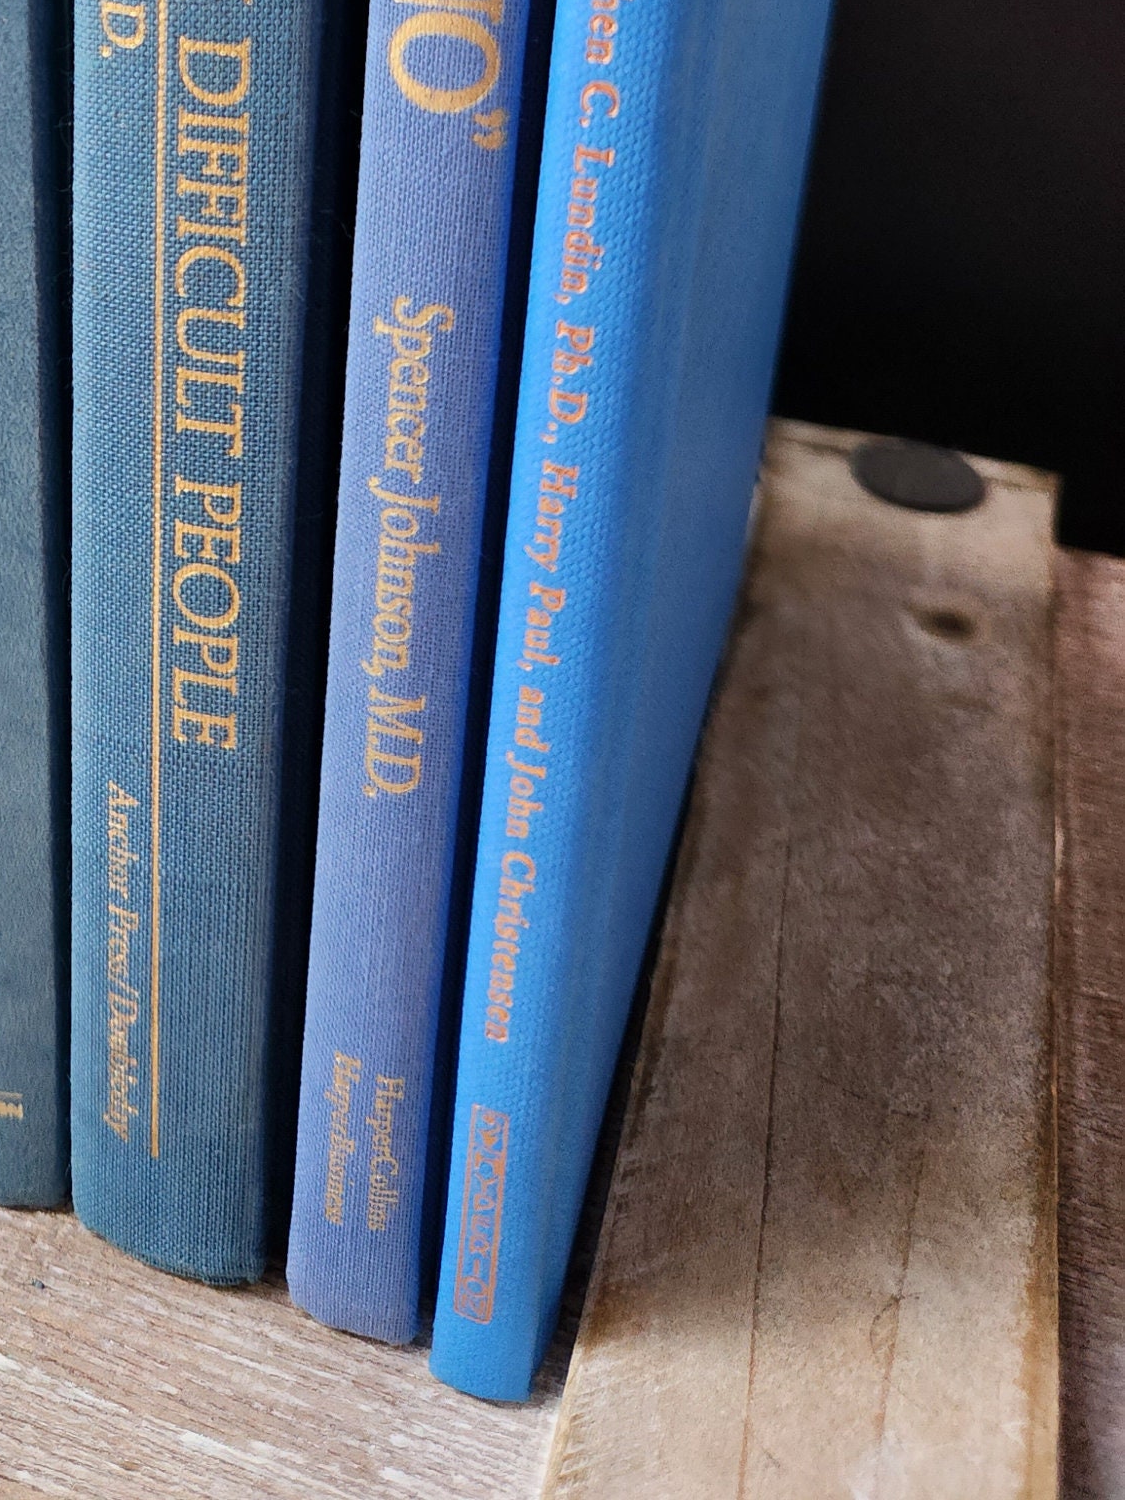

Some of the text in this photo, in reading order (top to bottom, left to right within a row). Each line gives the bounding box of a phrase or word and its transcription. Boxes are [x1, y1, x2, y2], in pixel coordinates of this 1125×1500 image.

[577, 79, 621, 129] C.
[175, 35, 252, 459] DIFFICULT
[554, 143, 616, 305] Lundin,
[540, 318, 596, 445] Ph.D.,
[360, 296, 455, 798] Spencer Johnson, M.D.
[523, 458, 581, 574] Harry
[172, 475, 243, 752] PEOPLE
[516, 581, 568, 673] Paul,
[514, 684, 551, 753] and
[108, 779, 140, 899] Anchor
[506, 749, 548, 840] John
[484, 850, 537, 1043] Christensen
